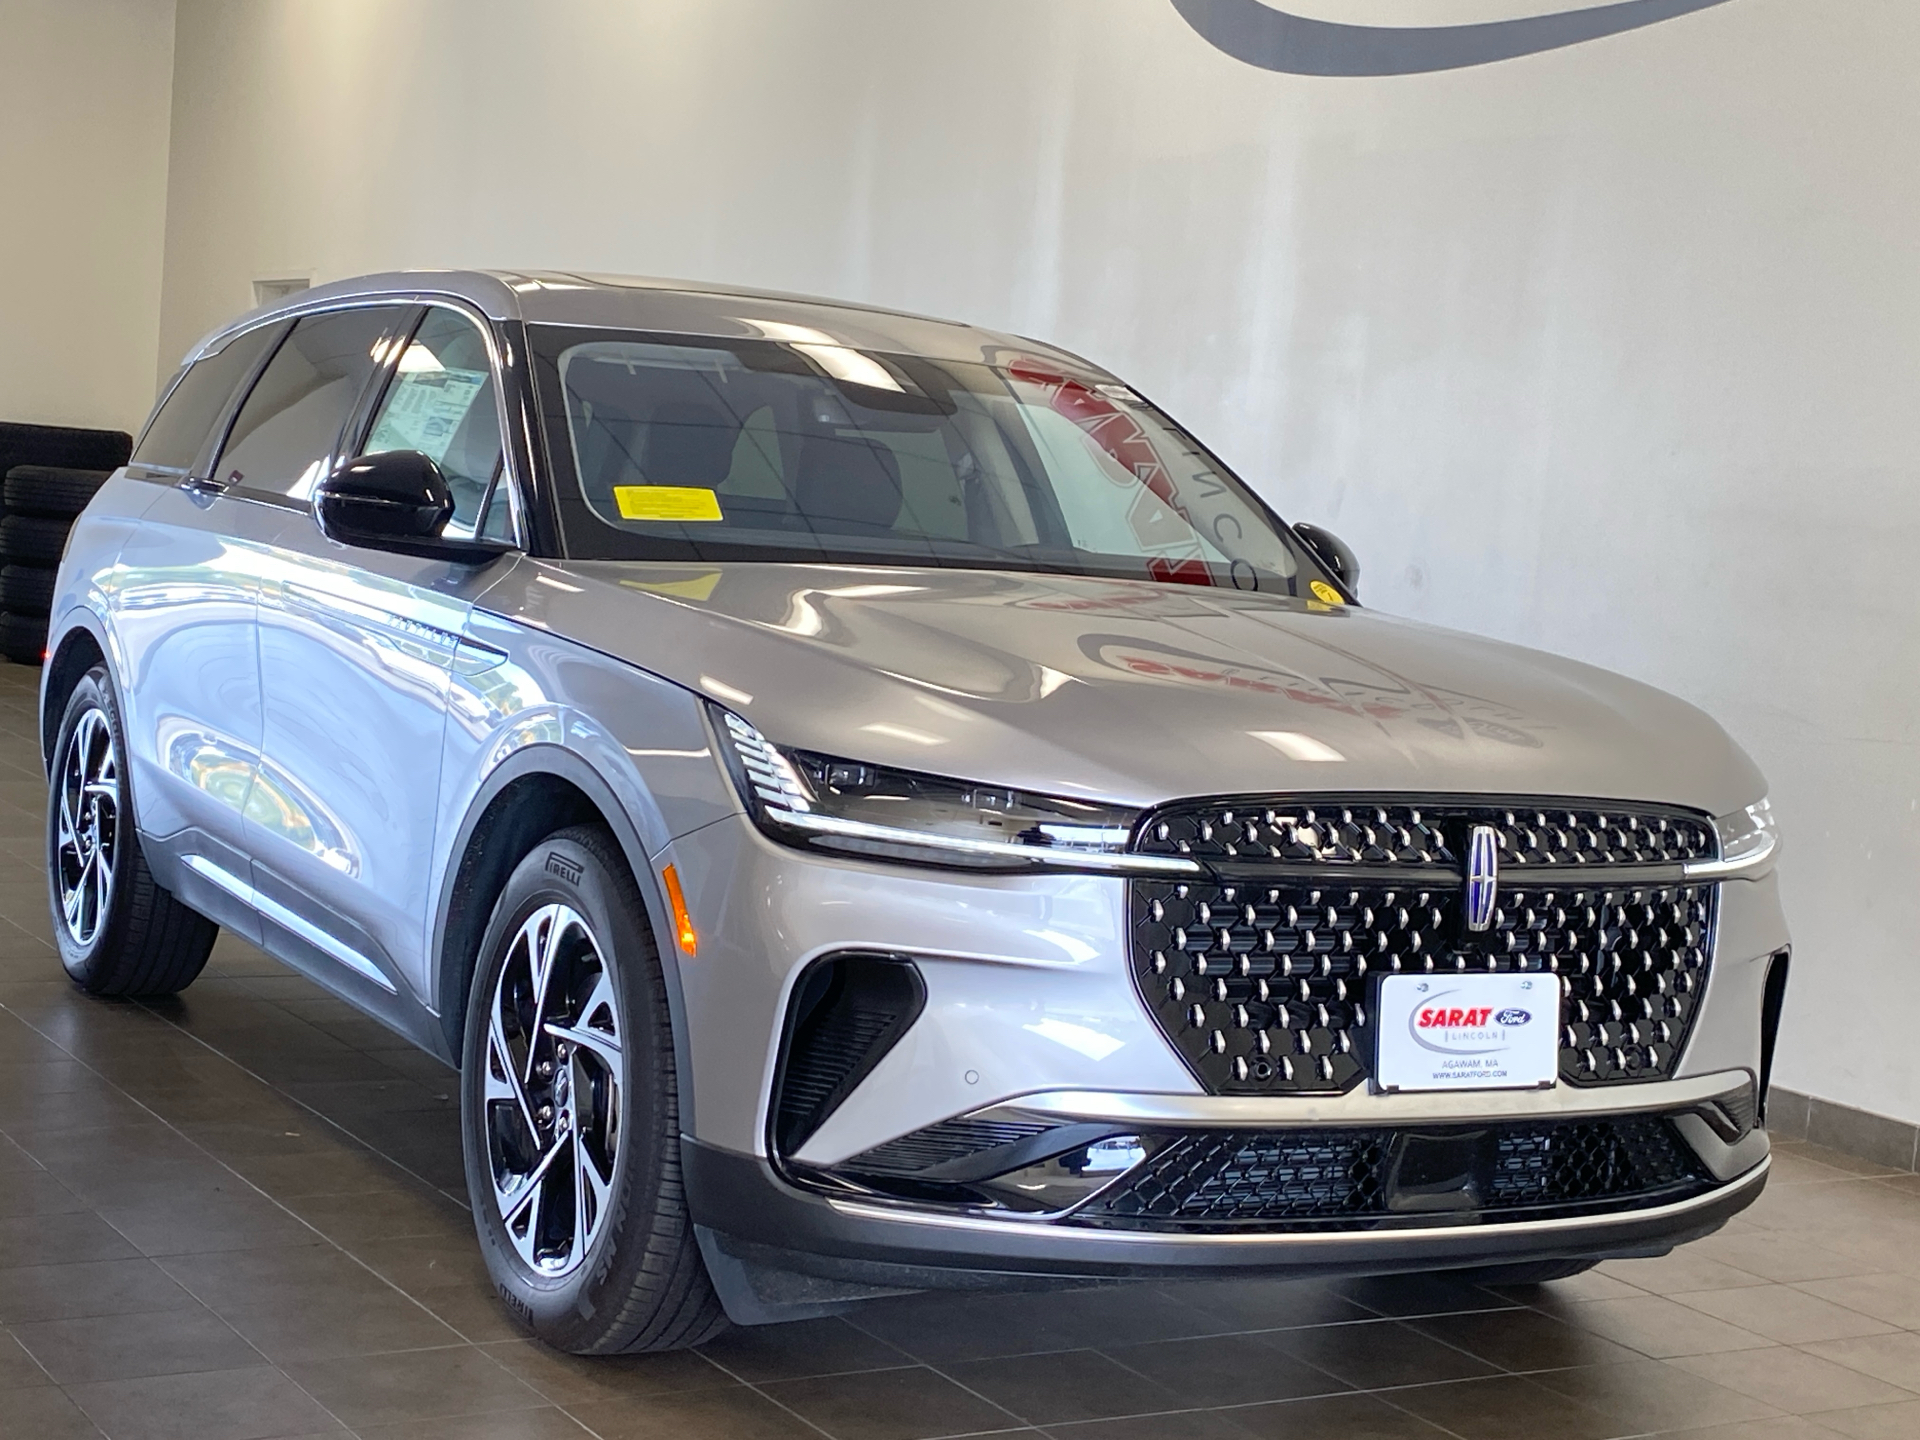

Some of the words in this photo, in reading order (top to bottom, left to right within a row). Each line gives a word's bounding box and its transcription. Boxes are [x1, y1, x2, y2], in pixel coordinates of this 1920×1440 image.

[544, 851, 585, 887] PIRELLI
[1418, 1006, 1494, 1029] SARAT
[1499, 1009, 1527, 1025] Ford
[1452, 1031, 1498, 1041] LINCOLN
[1442, 1060, 1482, 1069] AGAWAM,
[1485, 1059, 1498, 1068] MA
